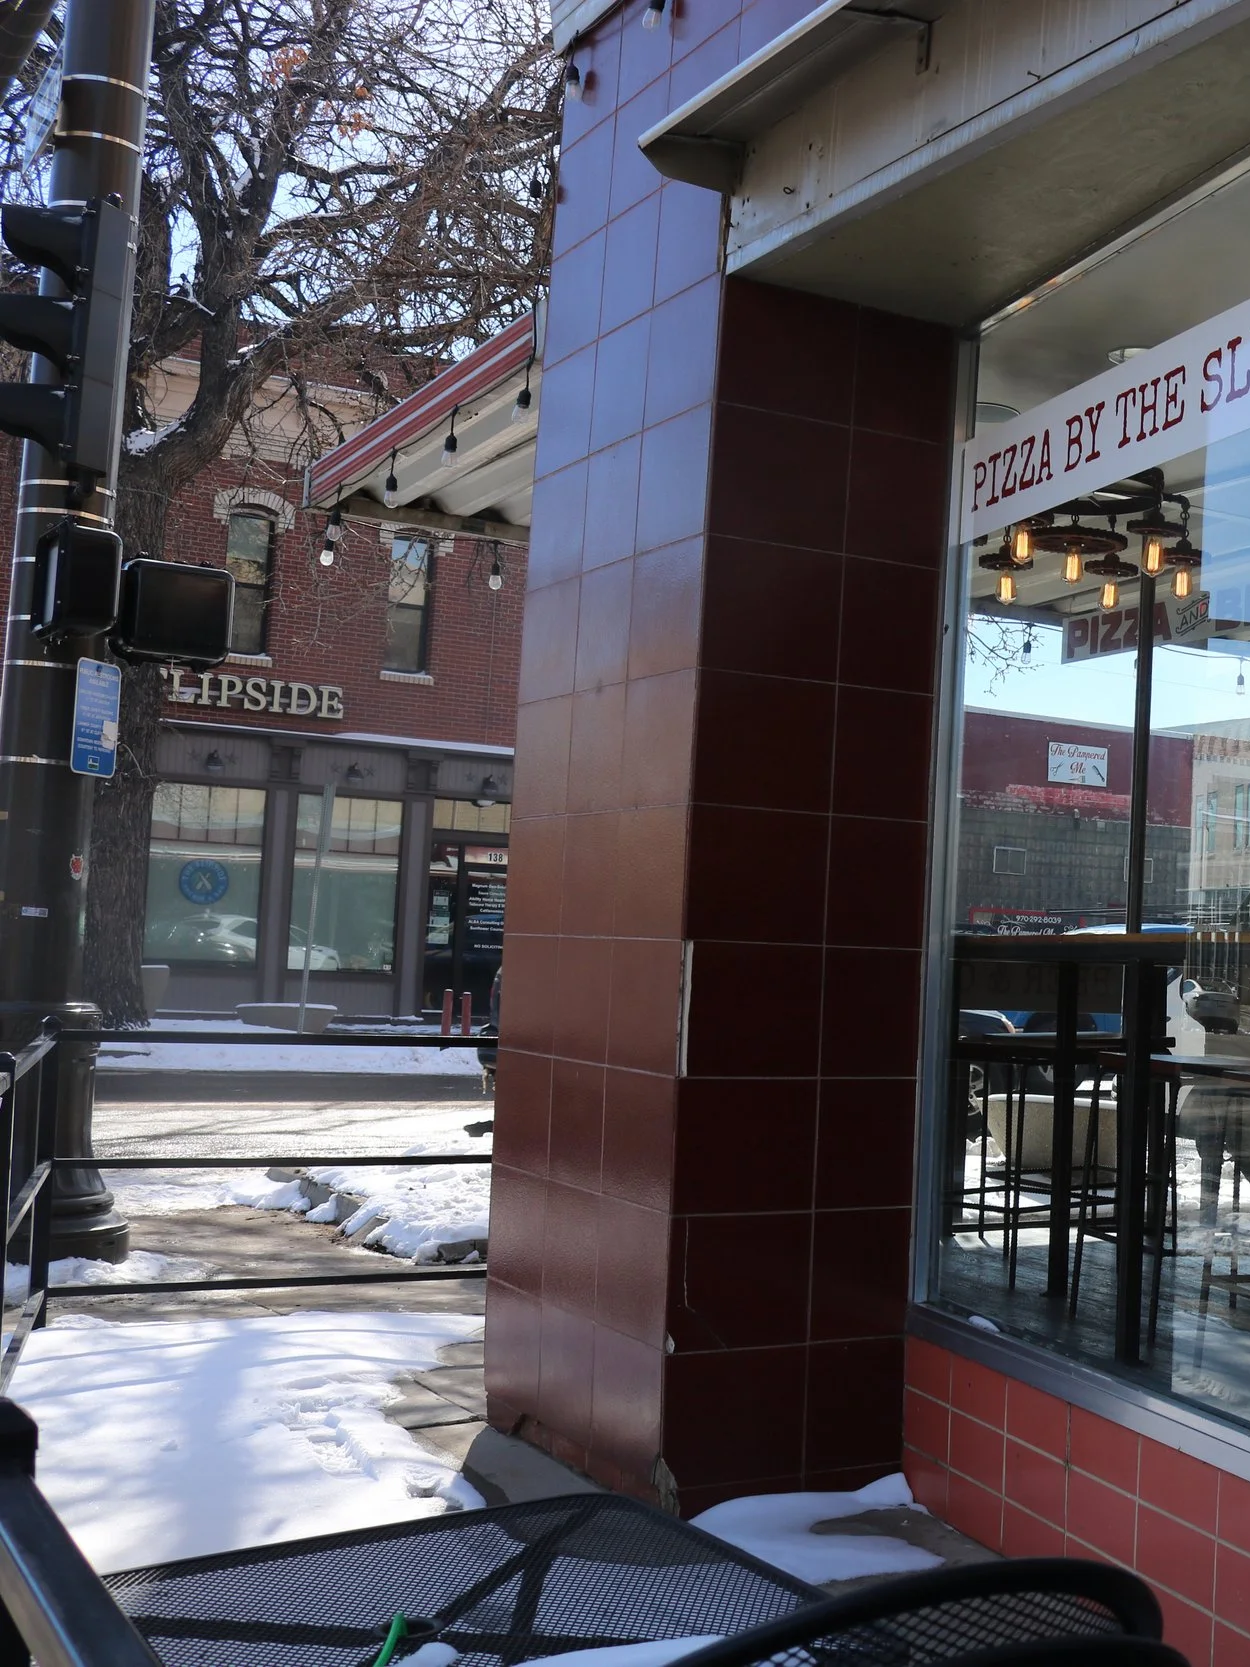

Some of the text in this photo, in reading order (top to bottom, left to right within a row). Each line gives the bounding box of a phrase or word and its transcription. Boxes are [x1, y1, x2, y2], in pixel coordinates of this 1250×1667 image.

[971, 428, 1053, 513] PIZZA
[1064, 401, 1105, 473] BY
[1115, 364, 1187, 449] THE
[1067, 602, 1173, 659] PIZZA
[1180, 601, 1209, 627] AND
[160, 668, 343, 719] LIPSIDE
[1050, 744, 1106, 761] The Pampered
[1070, 762, 1087, 774] Me
[488, 853, 504, 862] 138
[1016, 915, 1061, 924] 970-292-8039
